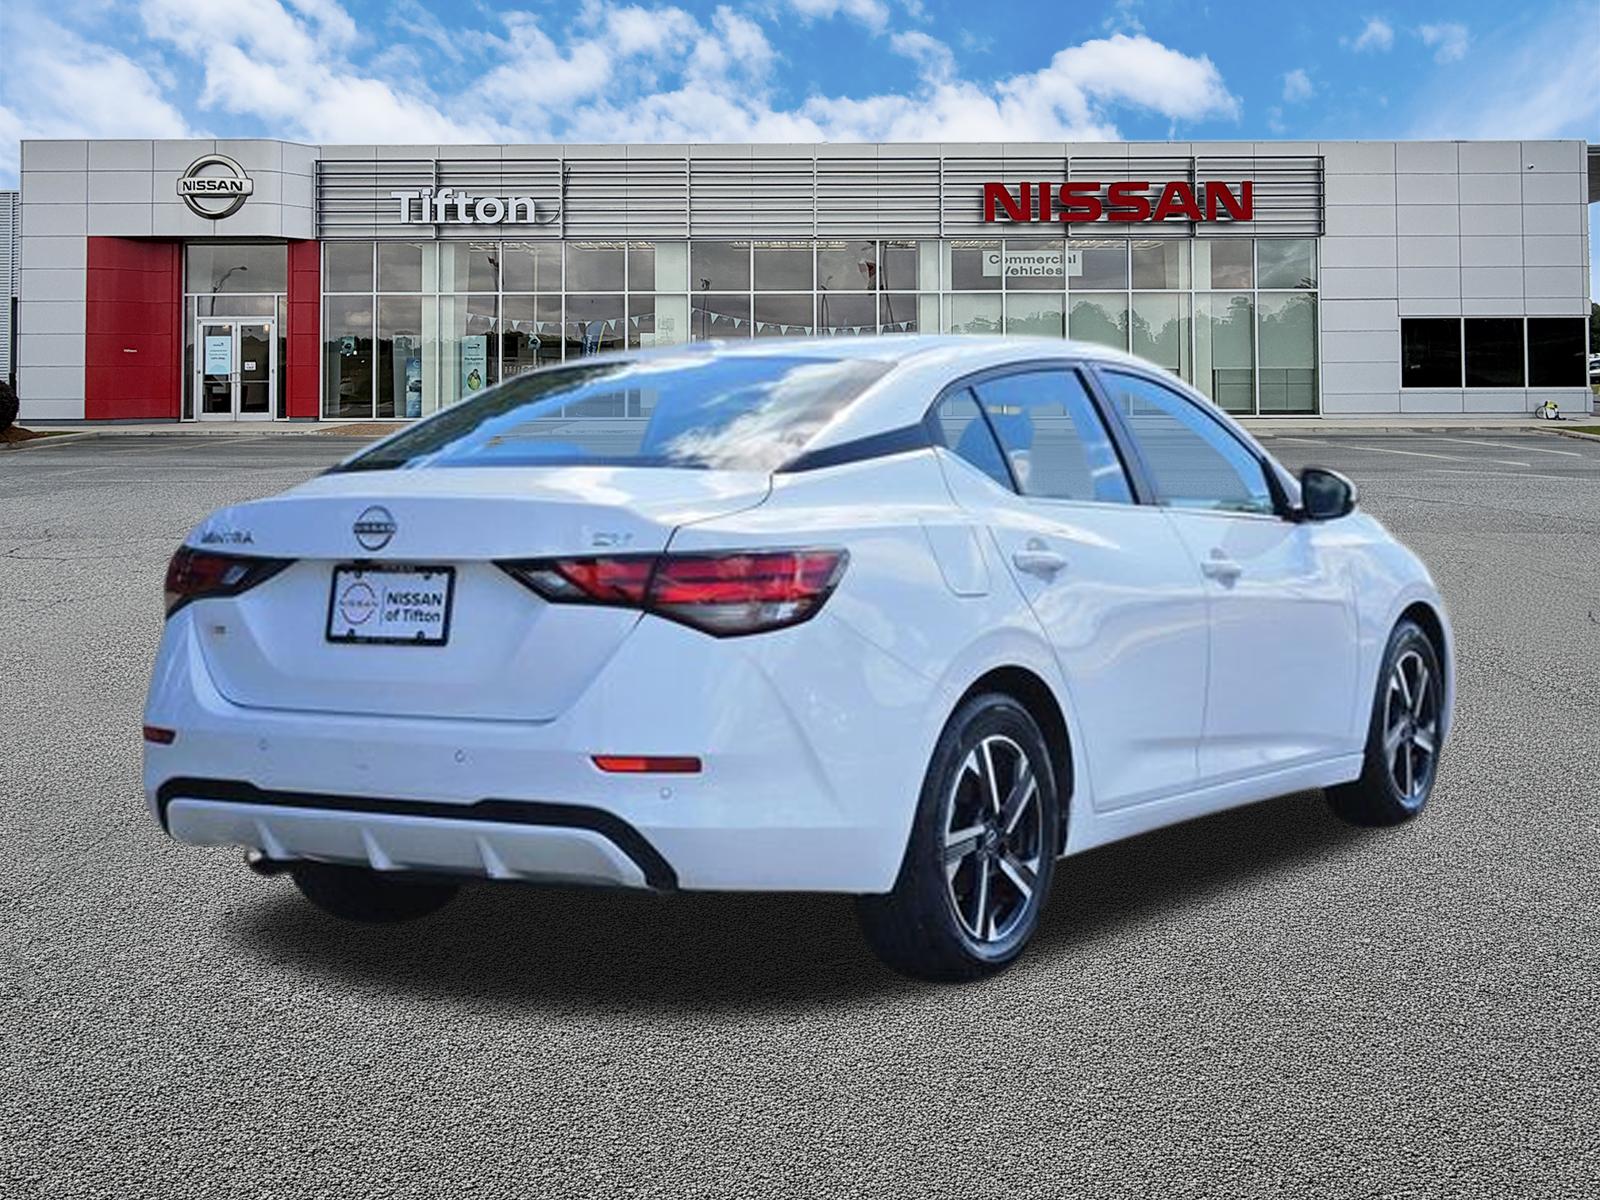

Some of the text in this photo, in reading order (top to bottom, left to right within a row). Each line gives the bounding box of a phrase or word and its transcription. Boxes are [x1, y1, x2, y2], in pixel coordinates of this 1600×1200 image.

[182, 180, 243, 191] NISSAN
[391, 188, 536, 224] Tifton
[983, 180, 1253, 222] NISSAN
[386, 592, 443, 606] NISSAN
[384, 608, 441, 622] of Tifton
